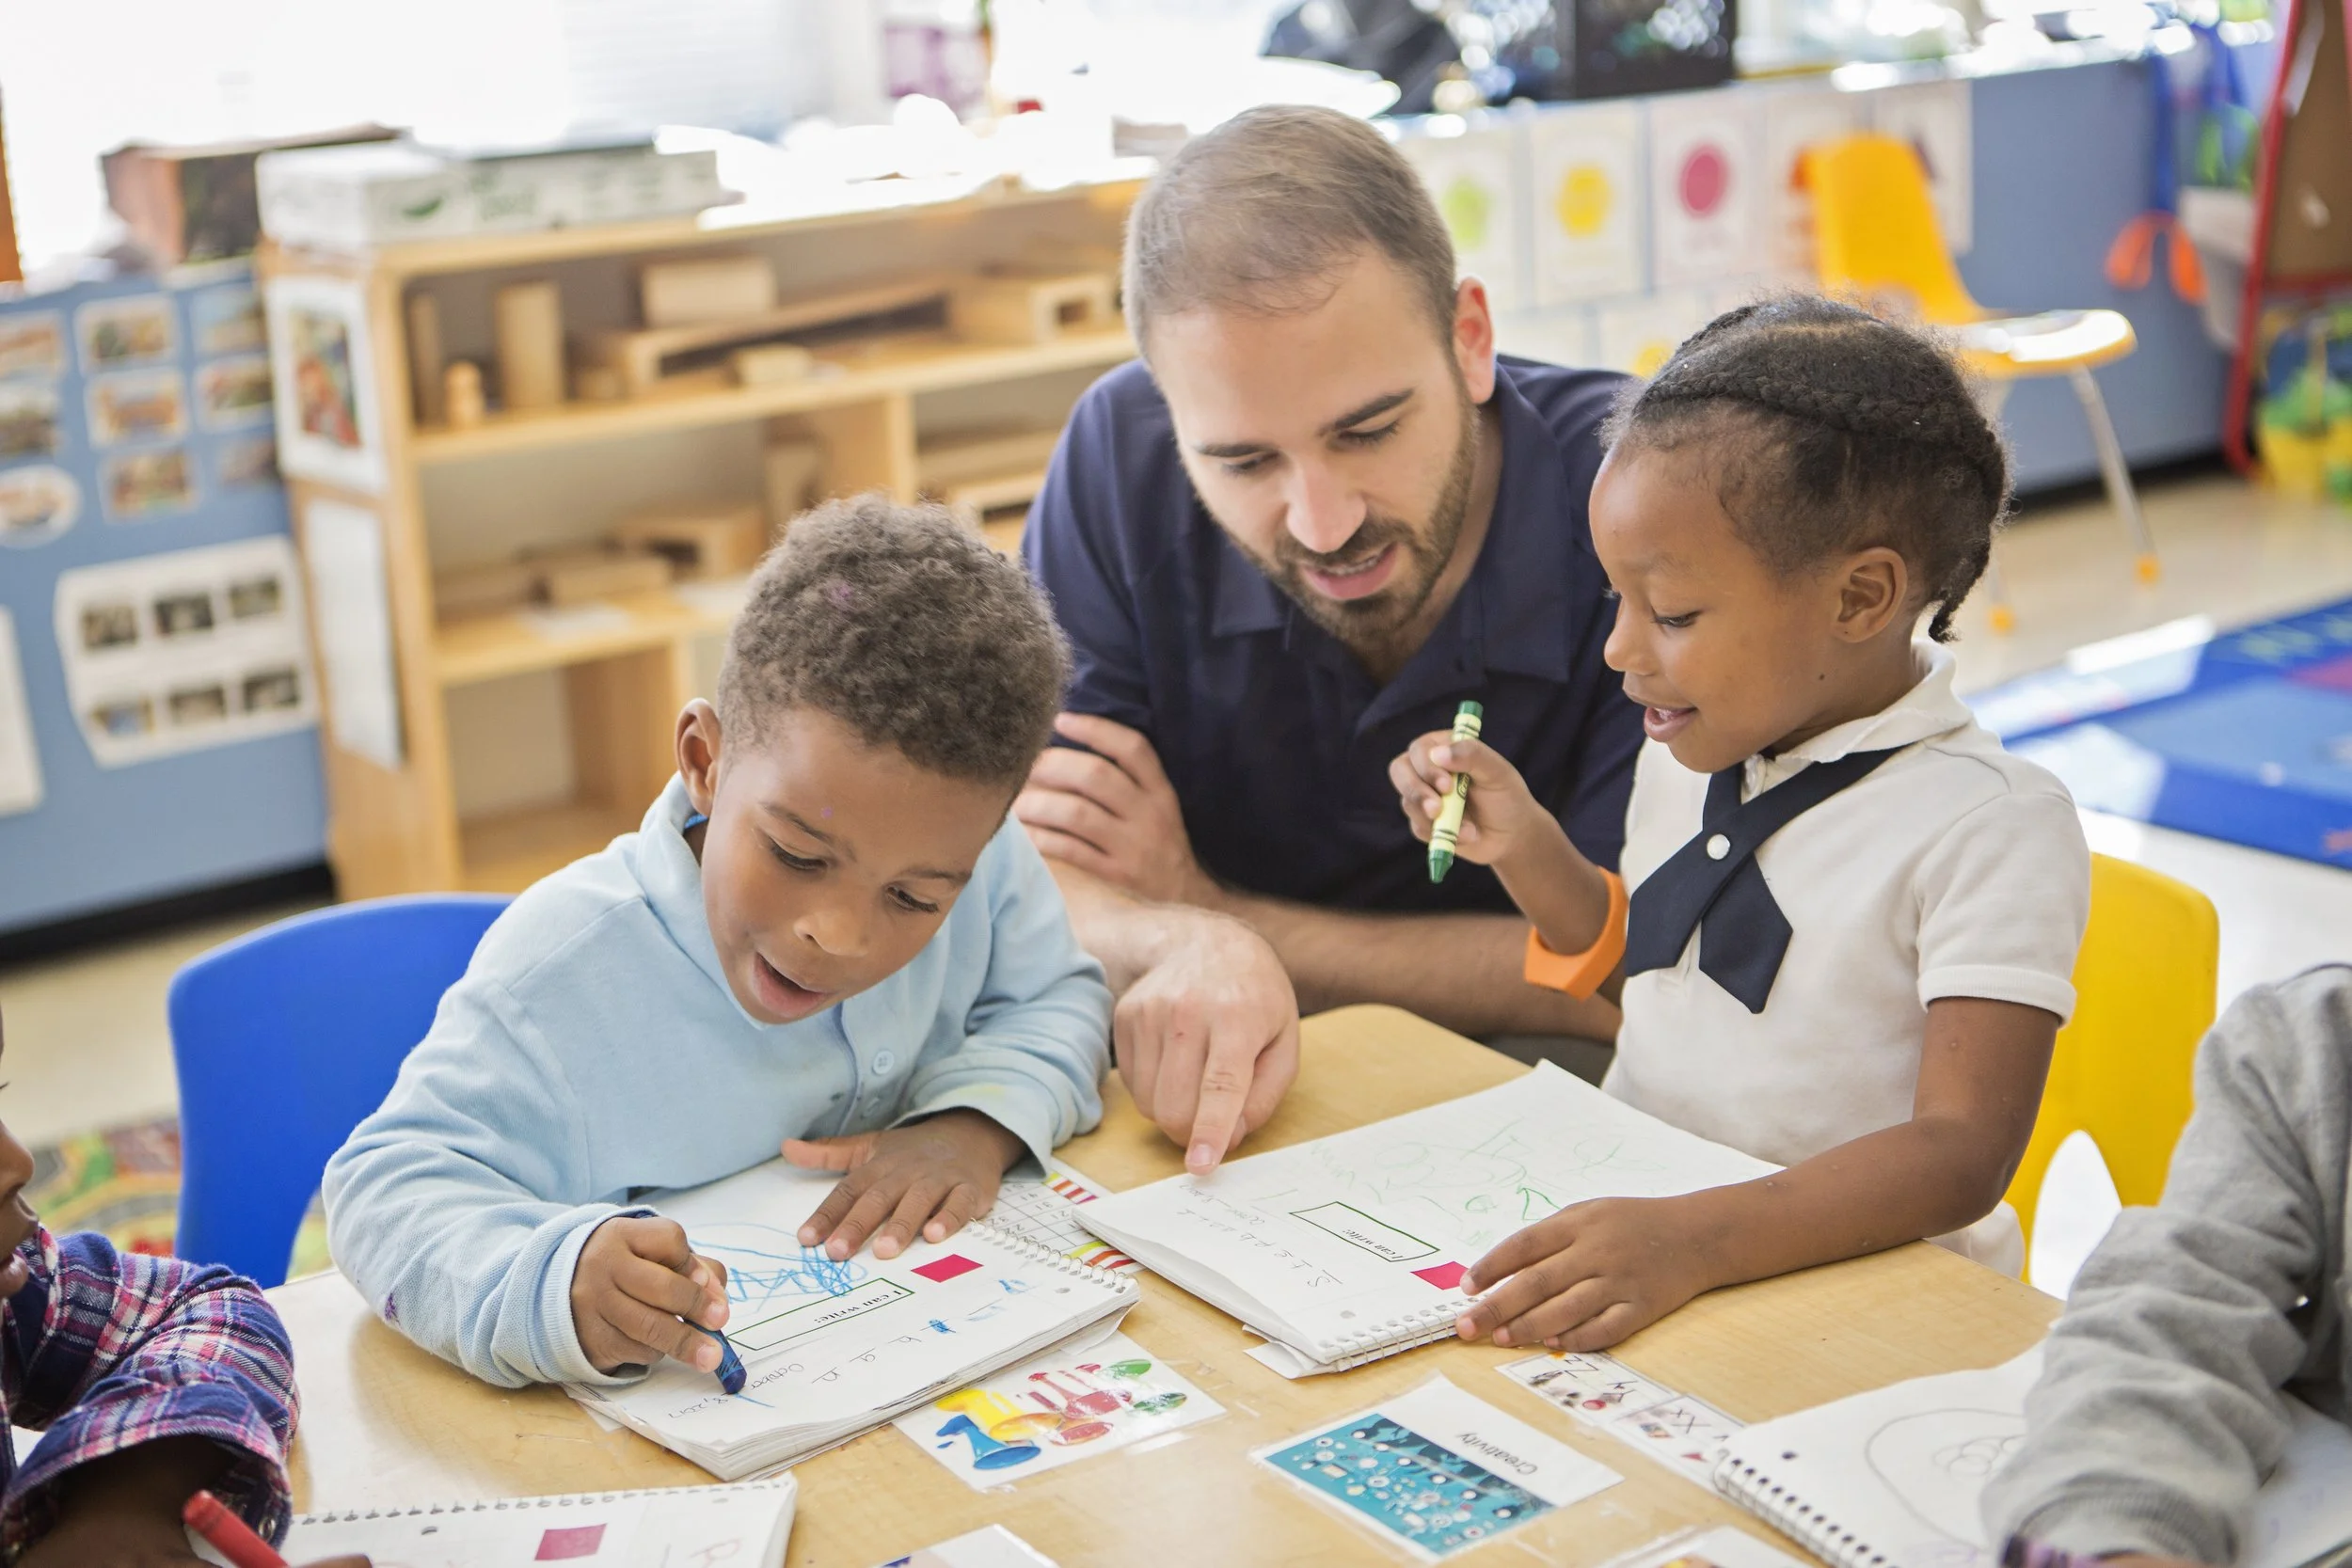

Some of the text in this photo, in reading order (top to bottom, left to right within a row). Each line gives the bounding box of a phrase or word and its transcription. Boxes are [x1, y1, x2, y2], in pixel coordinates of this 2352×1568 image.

[1342, 1228, 1375, 1245] write:
[1374, 1243, 1396, 1256] can
[863, 1293, 890, 1307] can
[813, 1306, 860, 1323] write:
[1455, 1431, 1538, 1476] Creativity
